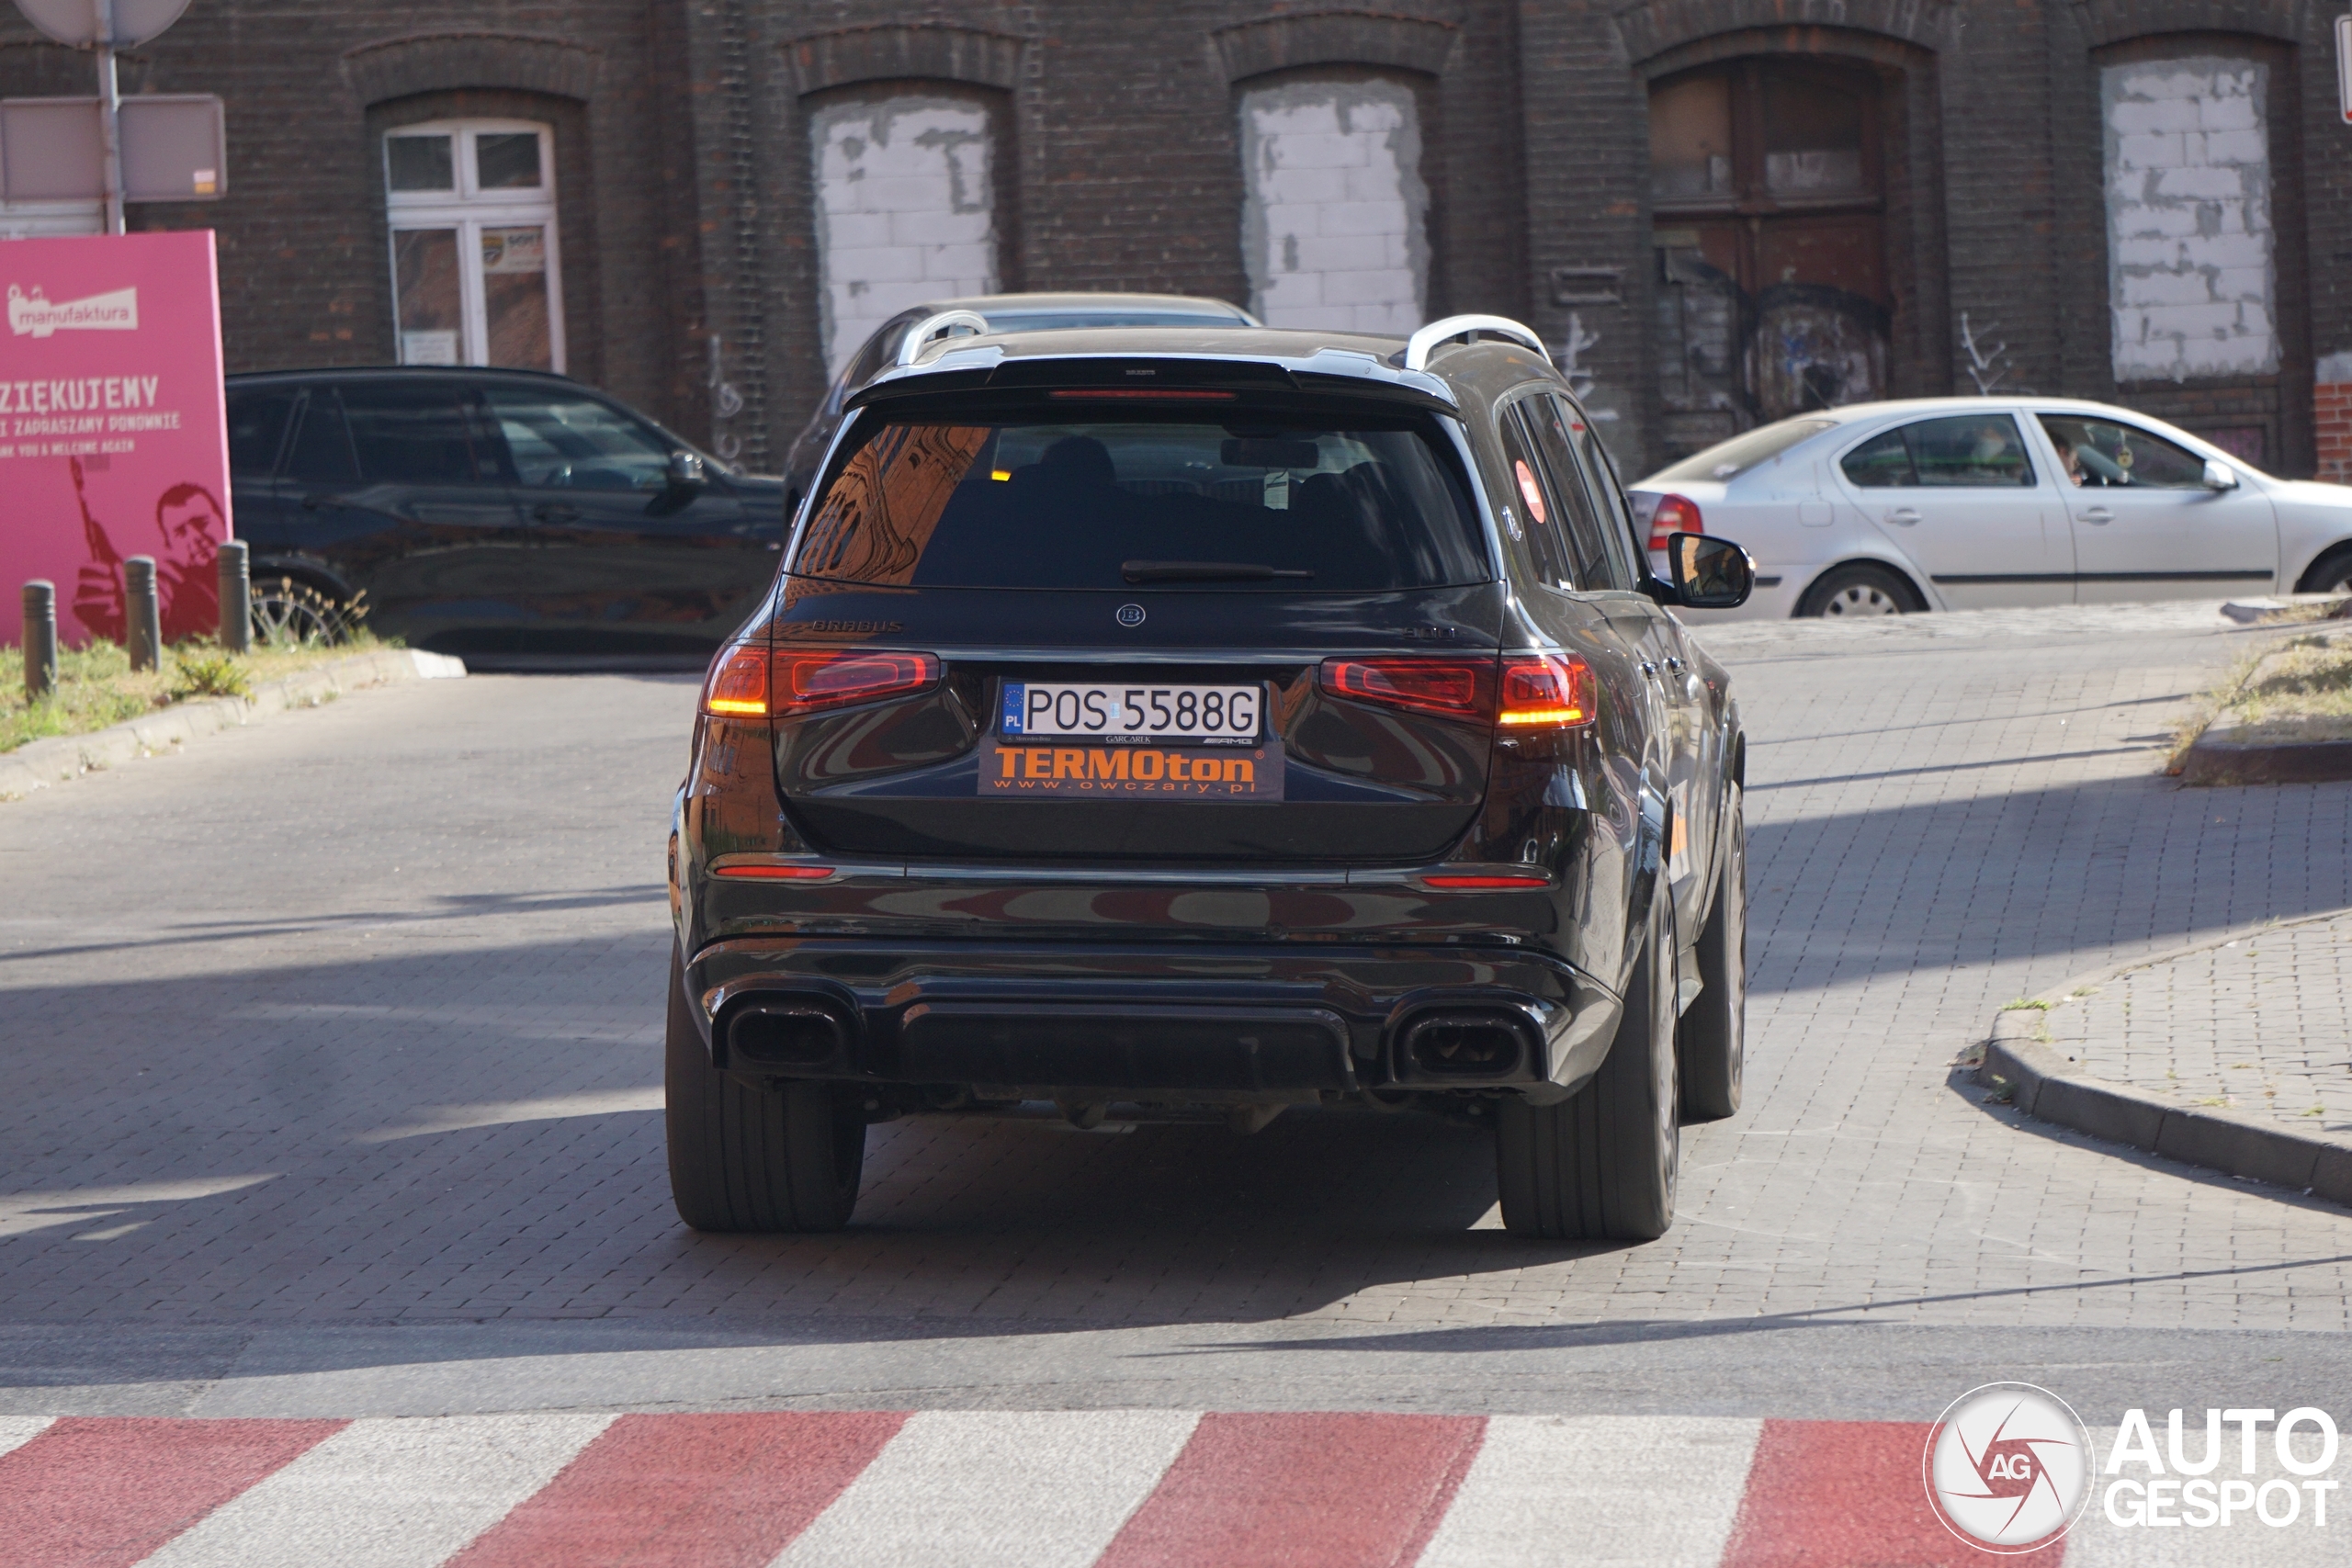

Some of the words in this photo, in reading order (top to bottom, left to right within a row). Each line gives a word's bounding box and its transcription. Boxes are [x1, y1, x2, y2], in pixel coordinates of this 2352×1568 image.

[19, 306, 129, 325] manufaktura
[0, 375, 158, 415] ZIĘKUJEMY
[14, 415, 105, 436] ZAPRASZAMY
[108, 412, 180, 433] PONOWNIE
[812, 620, 904, 633] BRABUS
[1027, 690, 1107, 730] POS
[1124, 691, 1253, 731] 5588G
[1006, 716, 1021, 728] PL
[1105, 736, 1151, 744] GARCAREK
[994, 780, 1256, 794] www.owczary.pl
